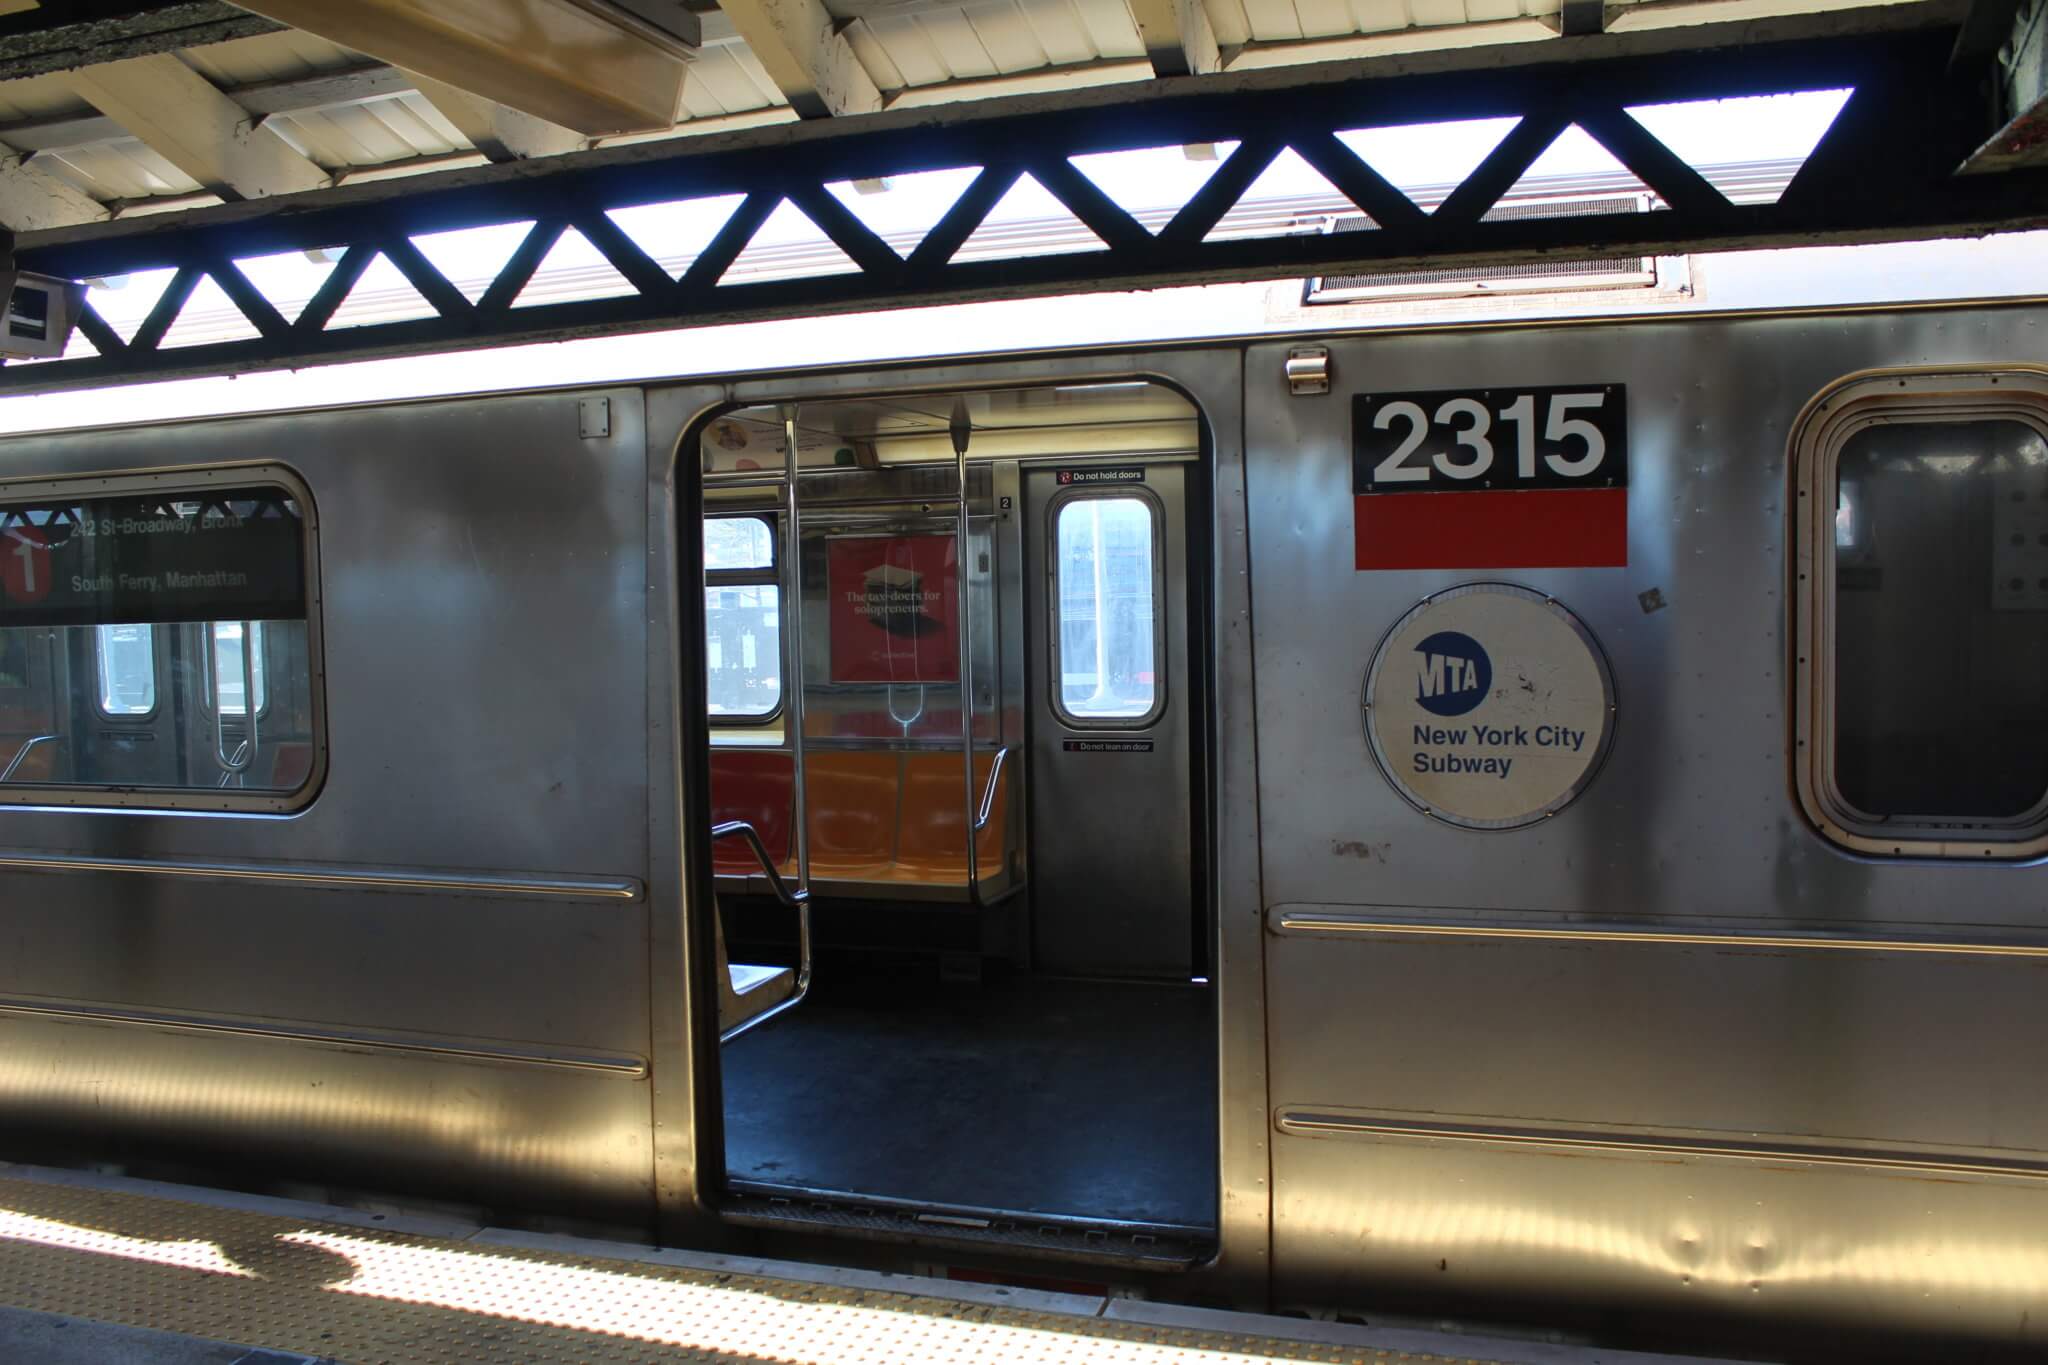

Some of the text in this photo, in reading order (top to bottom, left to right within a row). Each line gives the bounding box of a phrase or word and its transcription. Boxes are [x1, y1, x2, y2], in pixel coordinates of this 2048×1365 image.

[1373, 393, 1605, 482] 2315
[1073, 471, 1141, 481] Do not hold doors
[70, 519, 96, 537] 242
[201, 513, 245, 529] Bronx
[13, 539, 36, 592] 1
[71, 570, 247, 593] South Ferry, Manhattan
[846, 591, 866, 603] The
[923, 589, 941, 601] for
[1415, 651, 1478, 699] MTA
[1080, 743, 1150, 751] Do not lean on door
[1413, 725, 1585, 751] New York City
[1413, 752, 1512, 779] Subway
